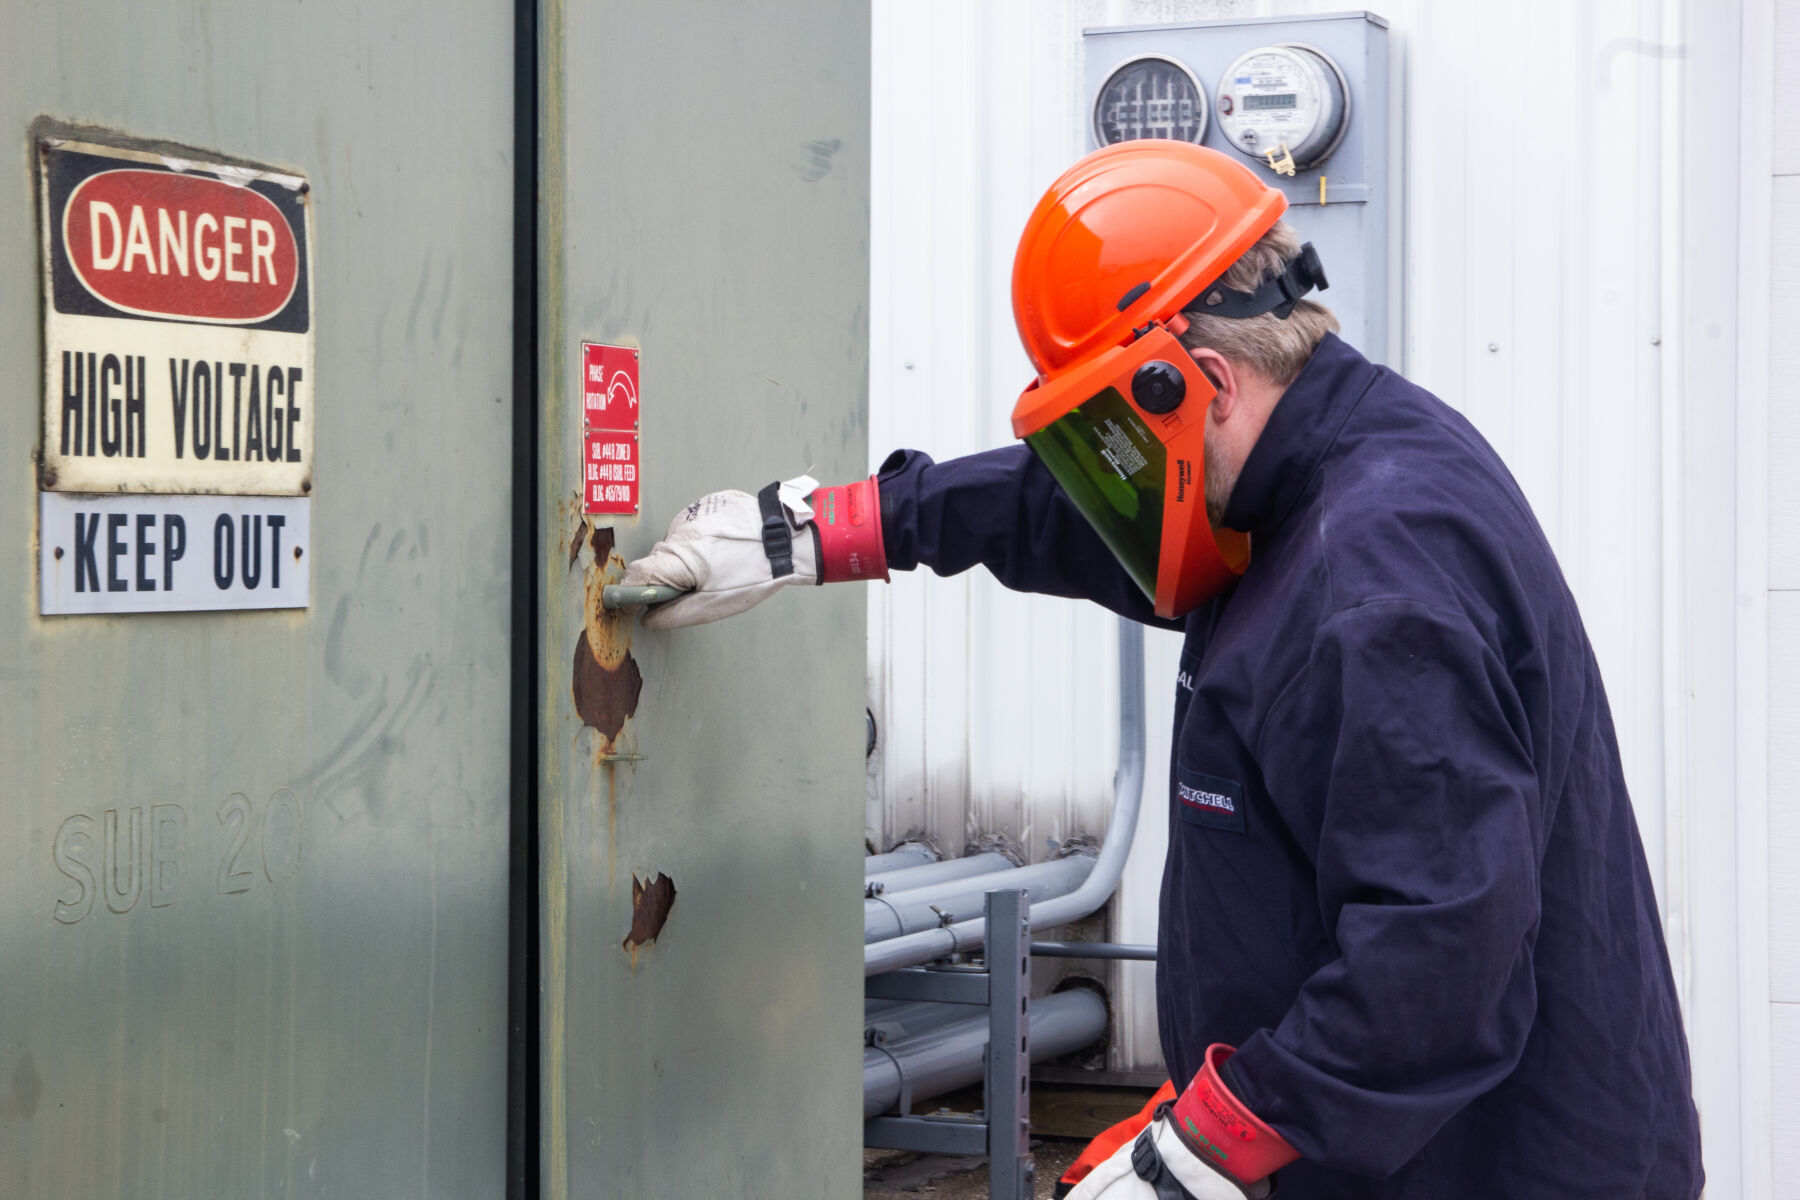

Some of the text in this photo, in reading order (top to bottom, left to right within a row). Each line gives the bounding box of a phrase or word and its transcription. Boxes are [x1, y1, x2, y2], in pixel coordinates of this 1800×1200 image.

[88, 199, 279, 286] DANGER
[60, 350, 303, 462] HIGH VOLTAGE
[1176, 459, 1185, 502] Honeywell
[75, 512, 286, 593] KEEP OUT
[53, 802, 186, 926] SUB
